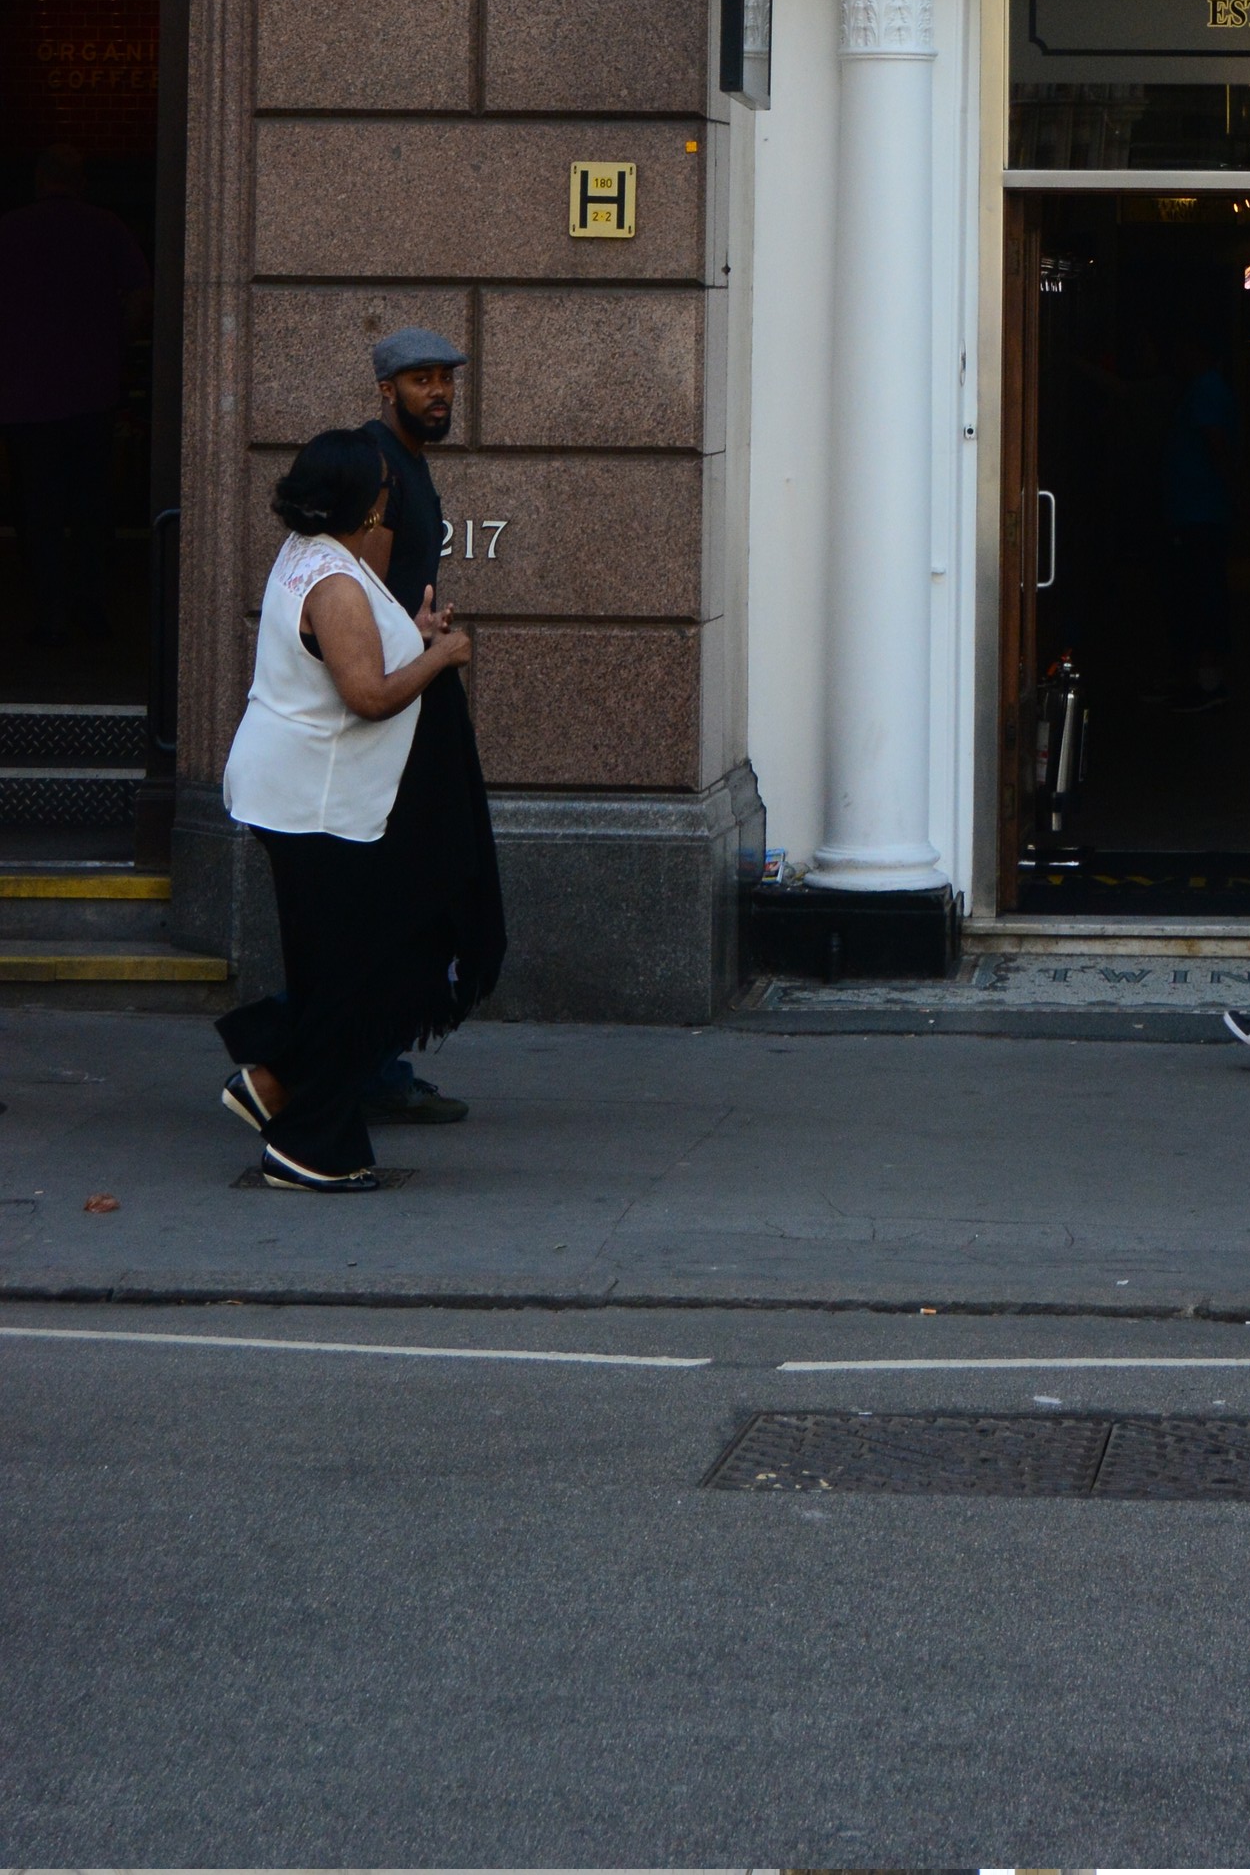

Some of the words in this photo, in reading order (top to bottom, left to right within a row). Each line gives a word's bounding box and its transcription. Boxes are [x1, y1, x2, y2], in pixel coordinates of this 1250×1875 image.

[37, 42, 157, 62] ORGANI
[594, 178, 613, 189] 180
[579, 170, 627, 230] H
[440, 520, 509, 559] 217
